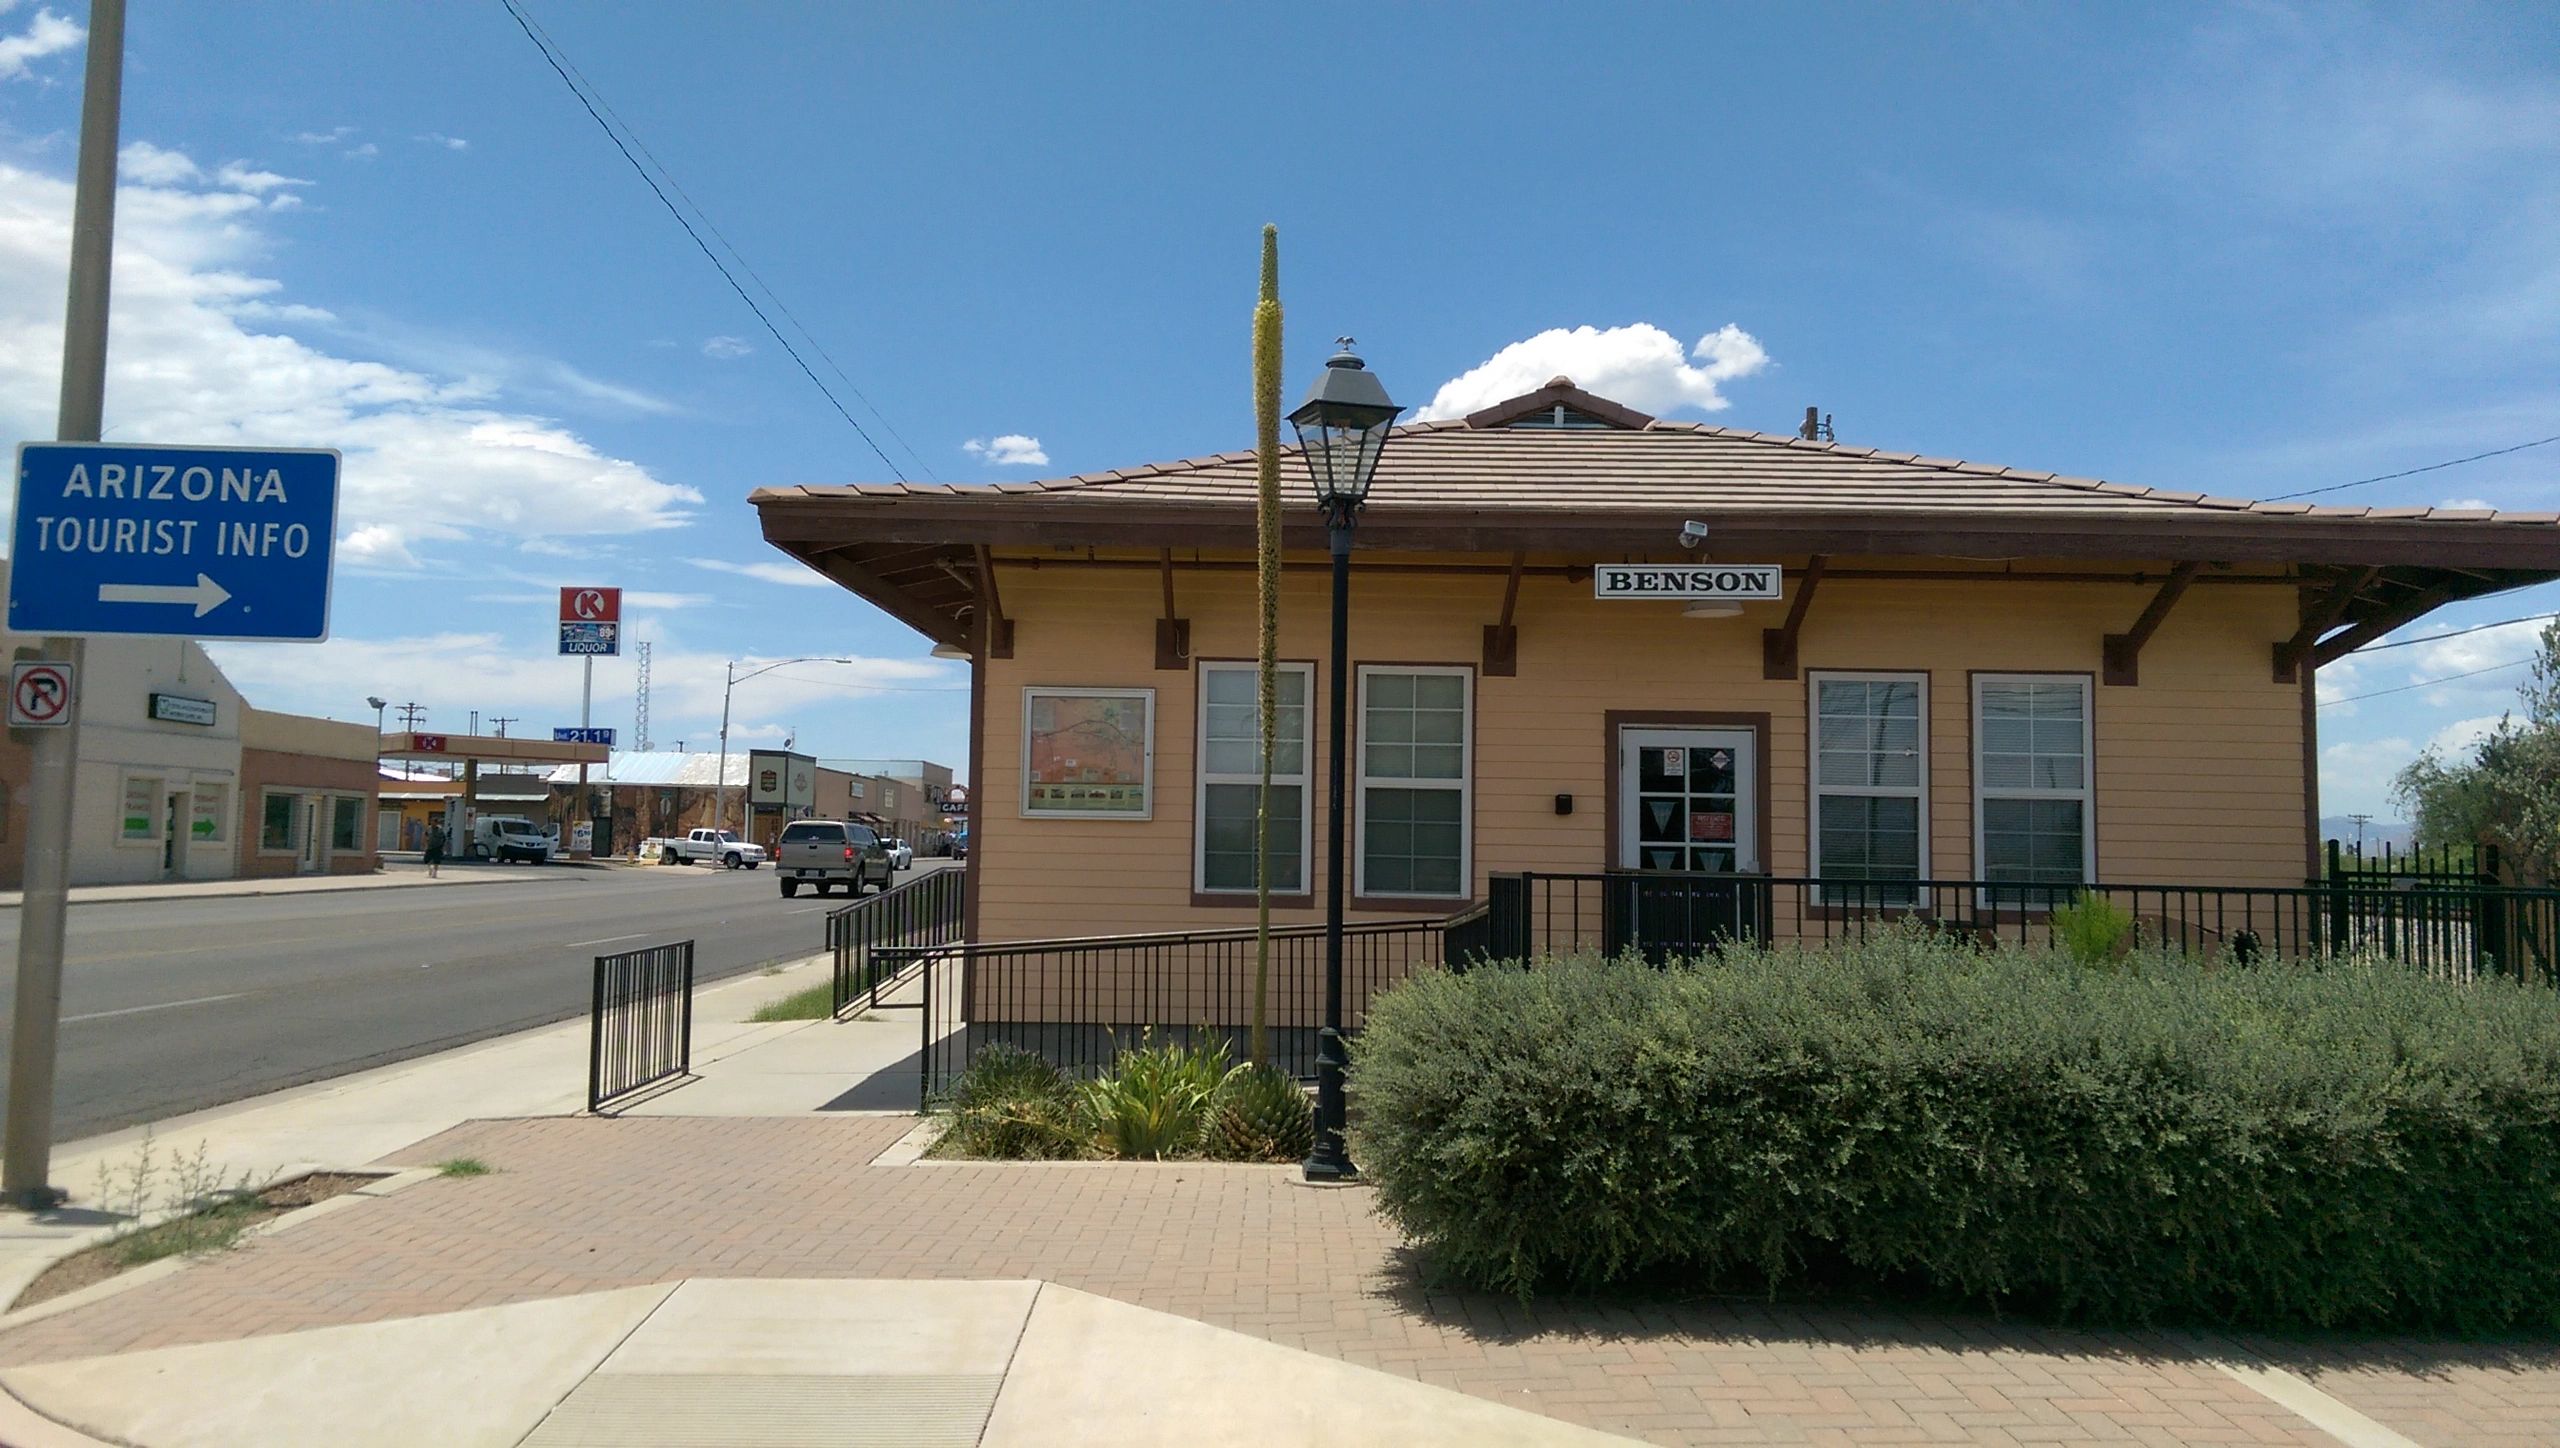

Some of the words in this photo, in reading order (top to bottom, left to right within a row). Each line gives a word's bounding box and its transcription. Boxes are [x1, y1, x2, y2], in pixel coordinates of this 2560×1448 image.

[62, 463, 287, 503] ARIZONA
[36, 516, 198, 555] TOURIST
[217, 521, 310, 558] INFO
[1606, 572, 1771, 592] BENSON
[578, 592, 603, 617] K
[568, 642, 608, 653] LIQUOR
